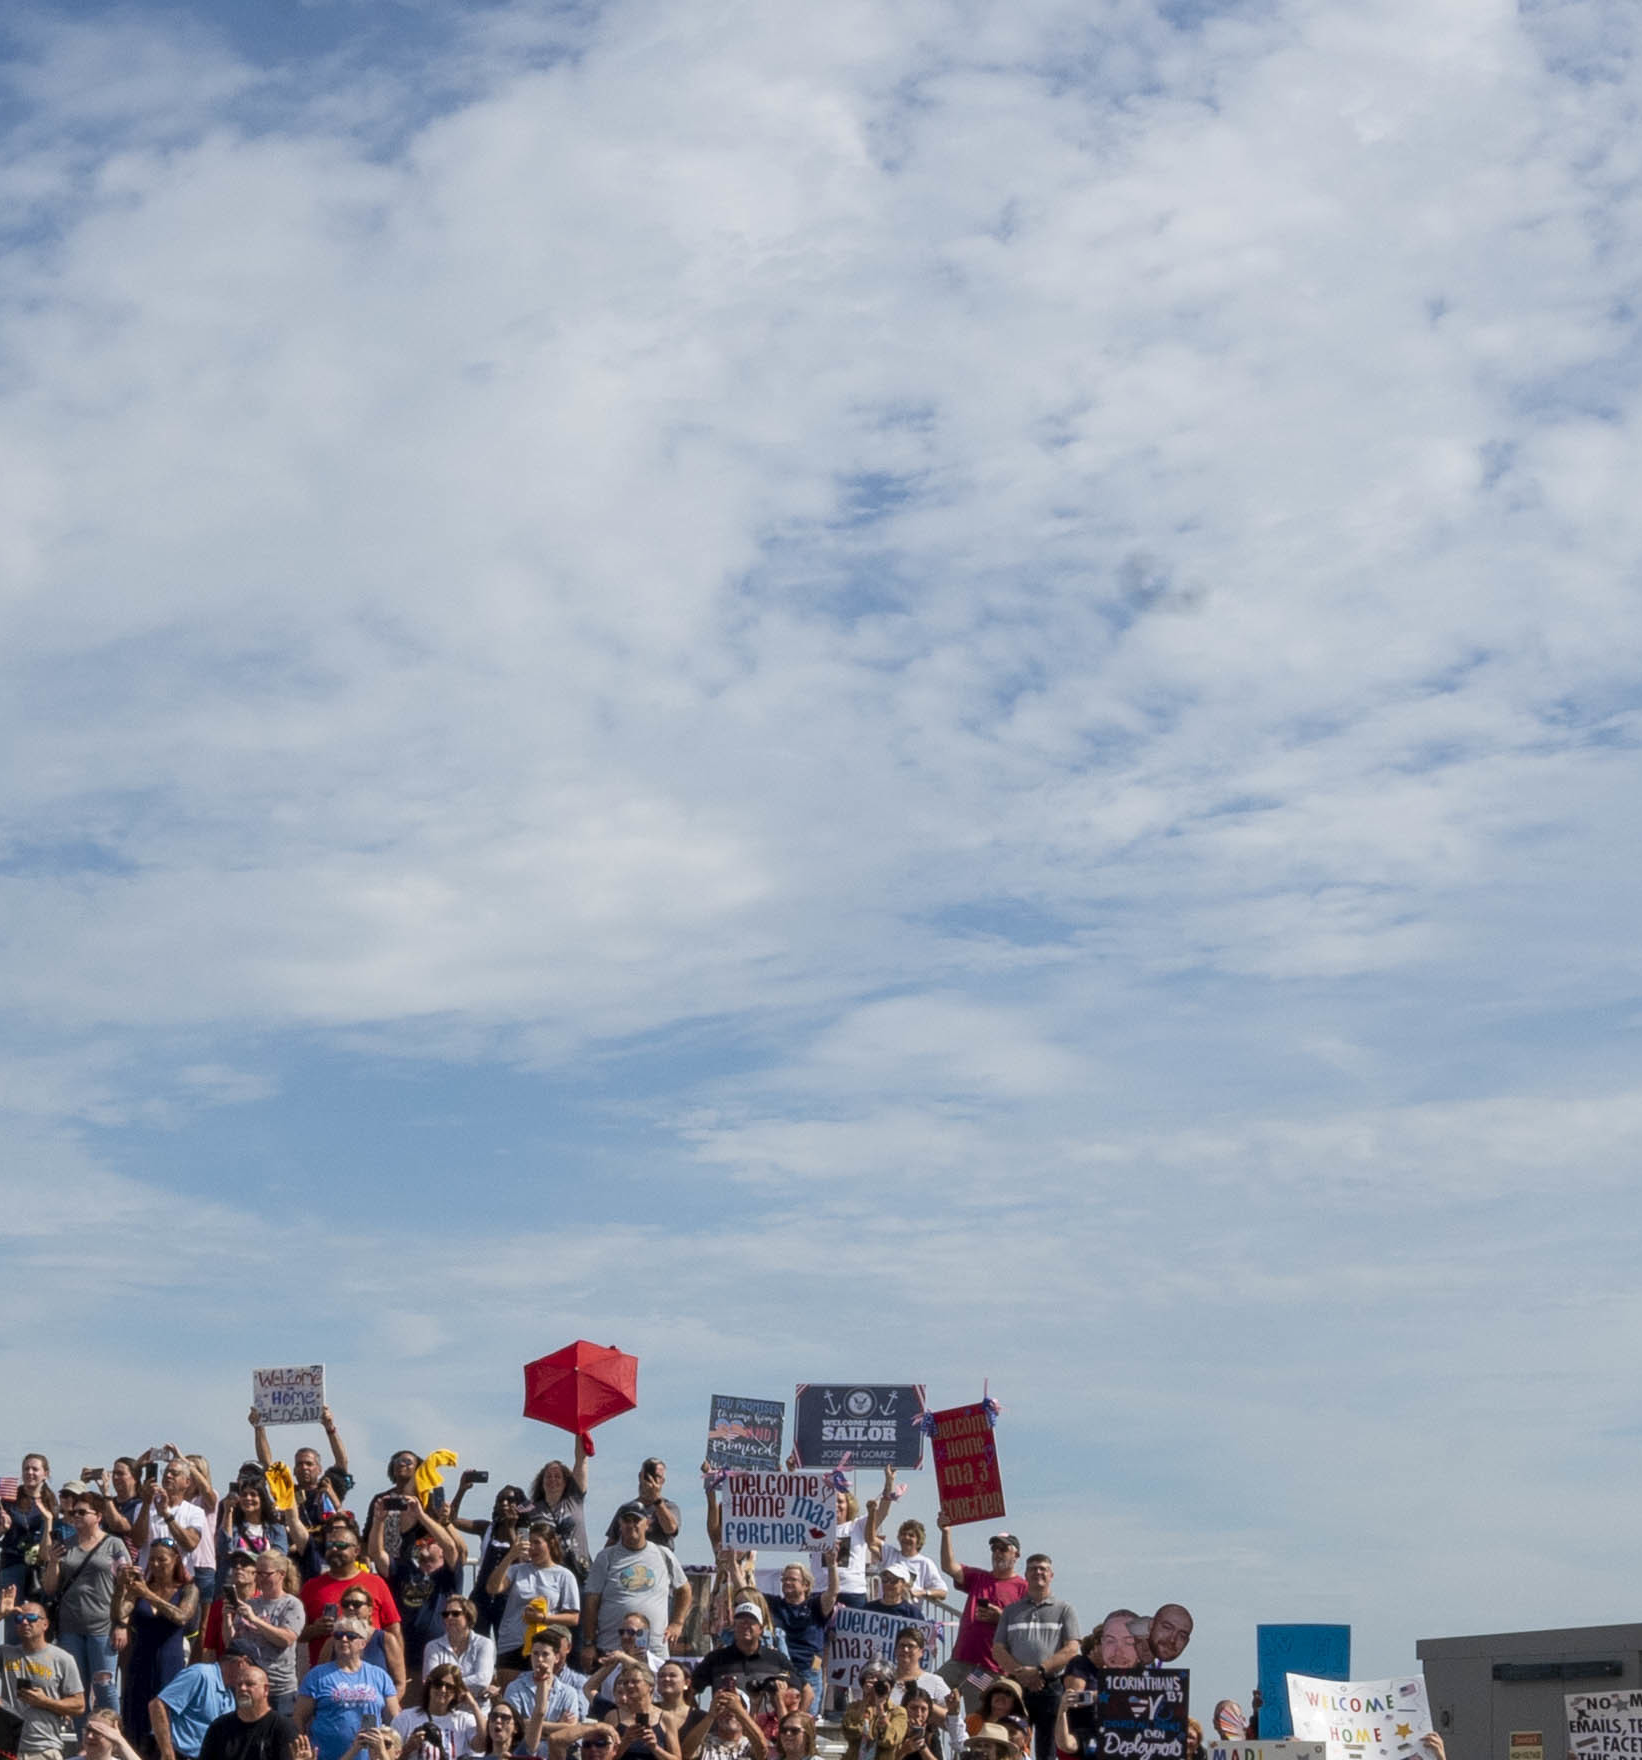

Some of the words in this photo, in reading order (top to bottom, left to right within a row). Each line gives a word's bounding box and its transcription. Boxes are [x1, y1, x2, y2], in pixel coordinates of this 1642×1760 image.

[822, 1419, 868, 1427] WELCOME
[869, 1419, 897, 1427] HOME
[822, 1427, 897, 1441] SAILOR
[1112, 1675, 1182, 1692] CORINTHIANS
[1305, 1692, 1395, 1714] WELCOME
[1587, 1697, 1612, 1711] NO
[1329, 1727, 1383, 1744] HOME
